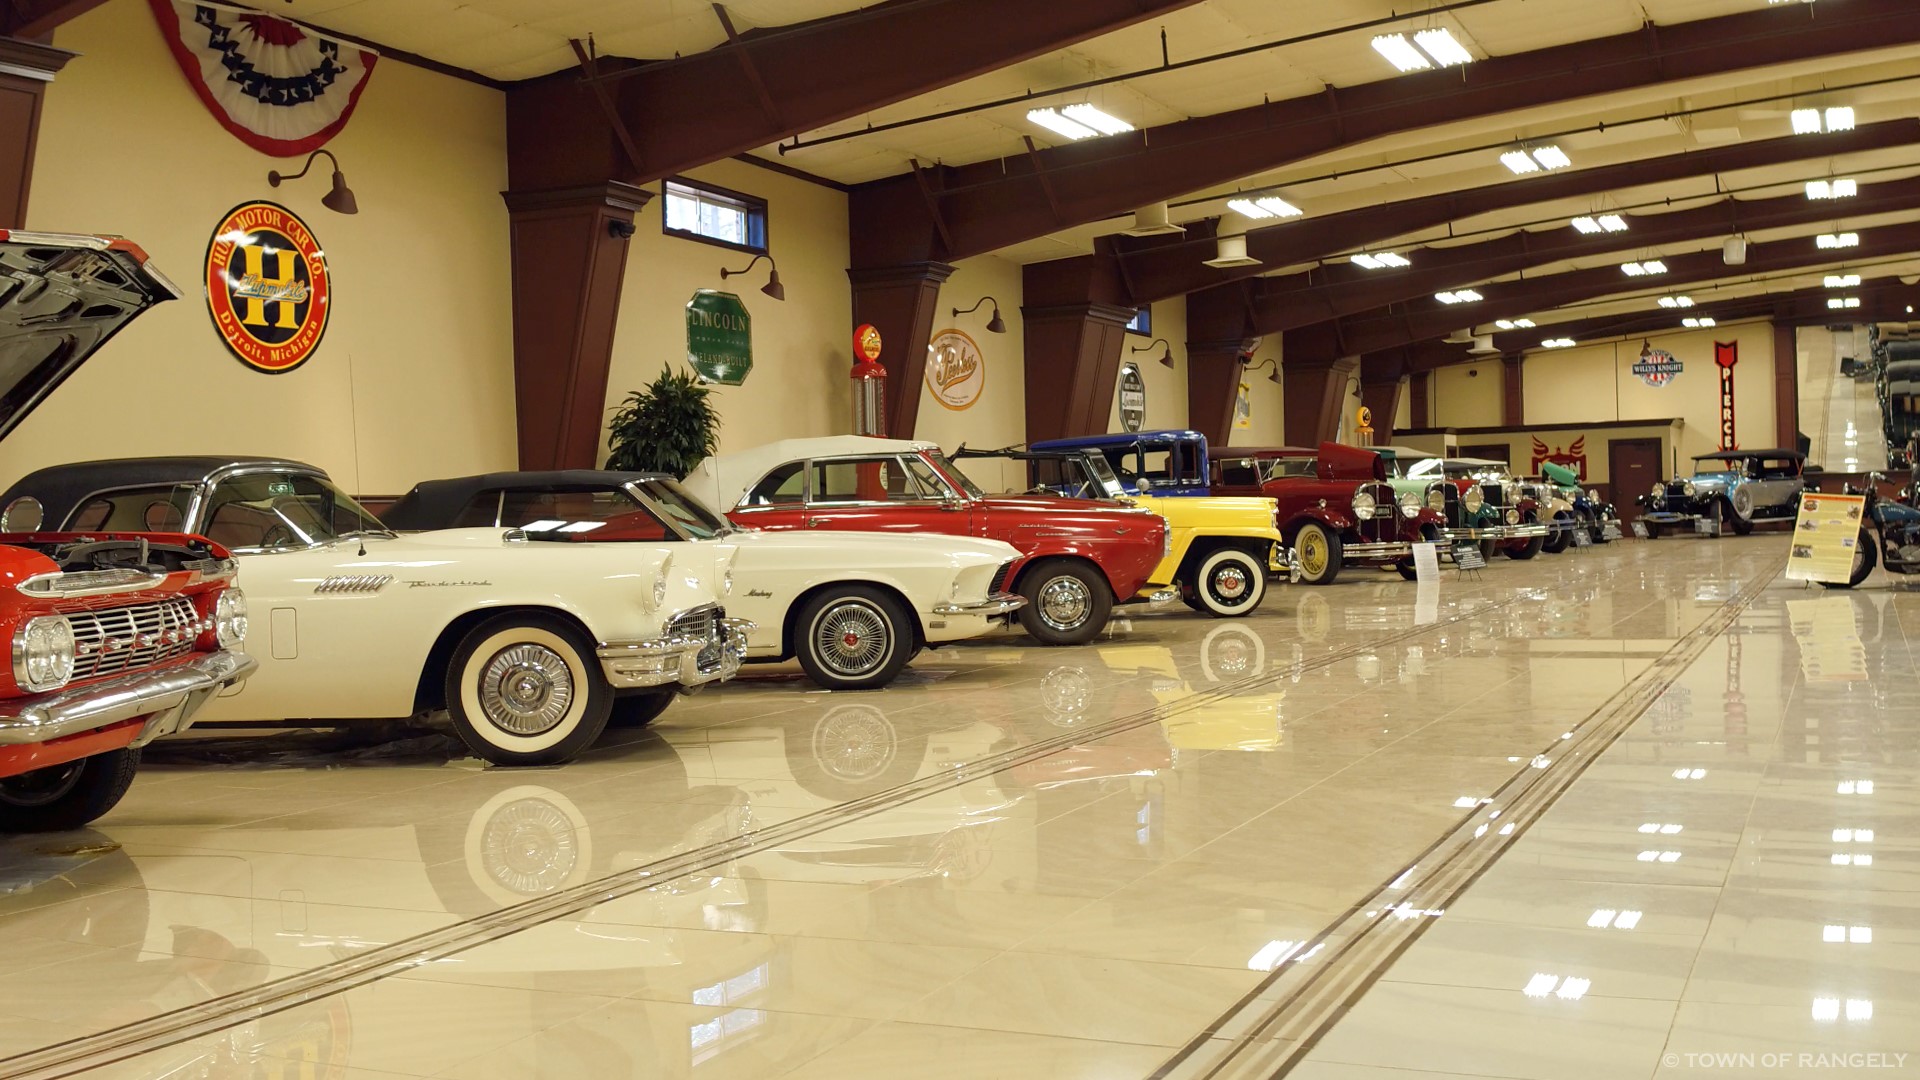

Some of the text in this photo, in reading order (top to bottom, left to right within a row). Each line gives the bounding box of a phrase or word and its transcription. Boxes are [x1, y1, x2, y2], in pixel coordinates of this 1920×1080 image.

[235, 209, 281, 231] MOTOR
[286, 220, 309, 249] CAR
[307, 252, 322, 279] CO.
[220, 311, 317, 361] Detroit, Michigan
[692, 310, 746, 331] LINCOLN
[1634, 364, 1682, 373] WILLYS KNIGHT
[1722, 367, 1732, 448] PIERCE
